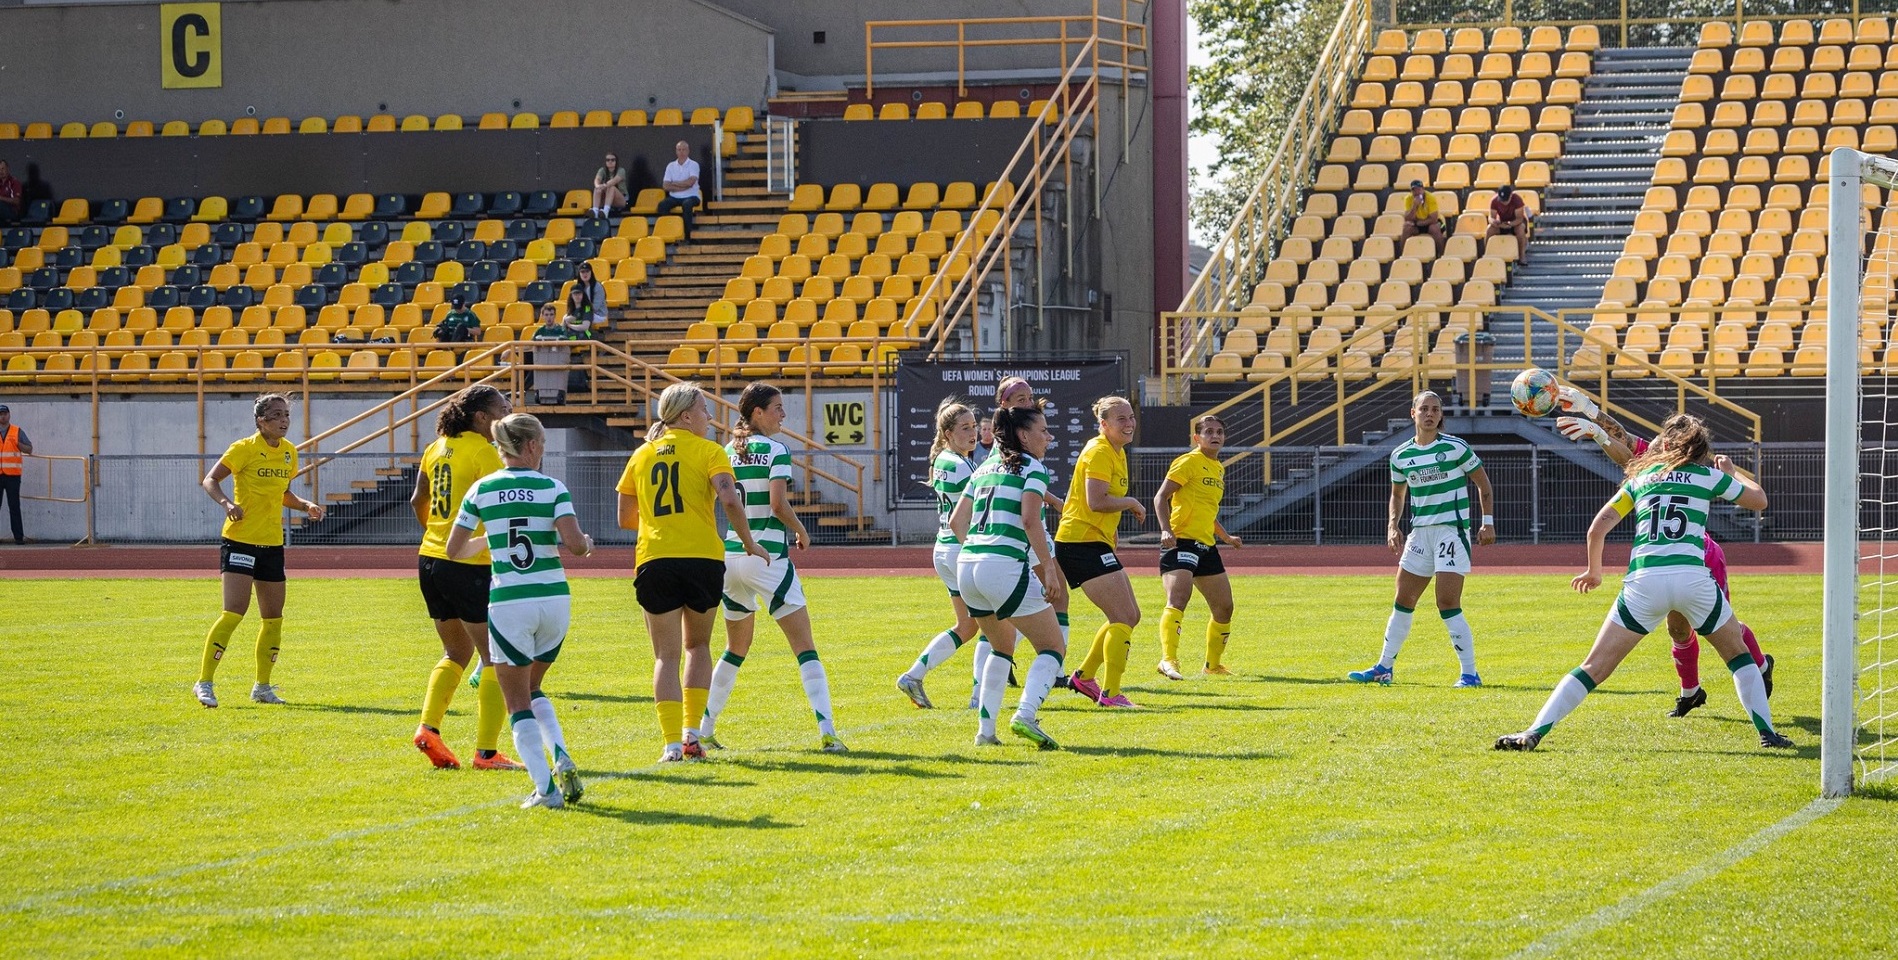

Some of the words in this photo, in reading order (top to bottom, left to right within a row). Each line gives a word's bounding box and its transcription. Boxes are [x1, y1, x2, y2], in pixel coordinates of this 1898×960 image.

[172, 13, 210, 78] C
[942, 370, 962, 381] UEFA
[1050, 369, 1081, 381] LEAGUE
[968, 385, 996, 396] ROUND
[825, 402, 863, 426] WC
[431, 463, 452, 519] 19
[499, 489, 534, 503] ROSS
[651, 461, 685, 517] 21
[978, 485, 996, 533] 7
[1648, 495, 1690, 541] 15
[508, 517, 535, 570] 5
[1438, 541, 1456, 559] 24
